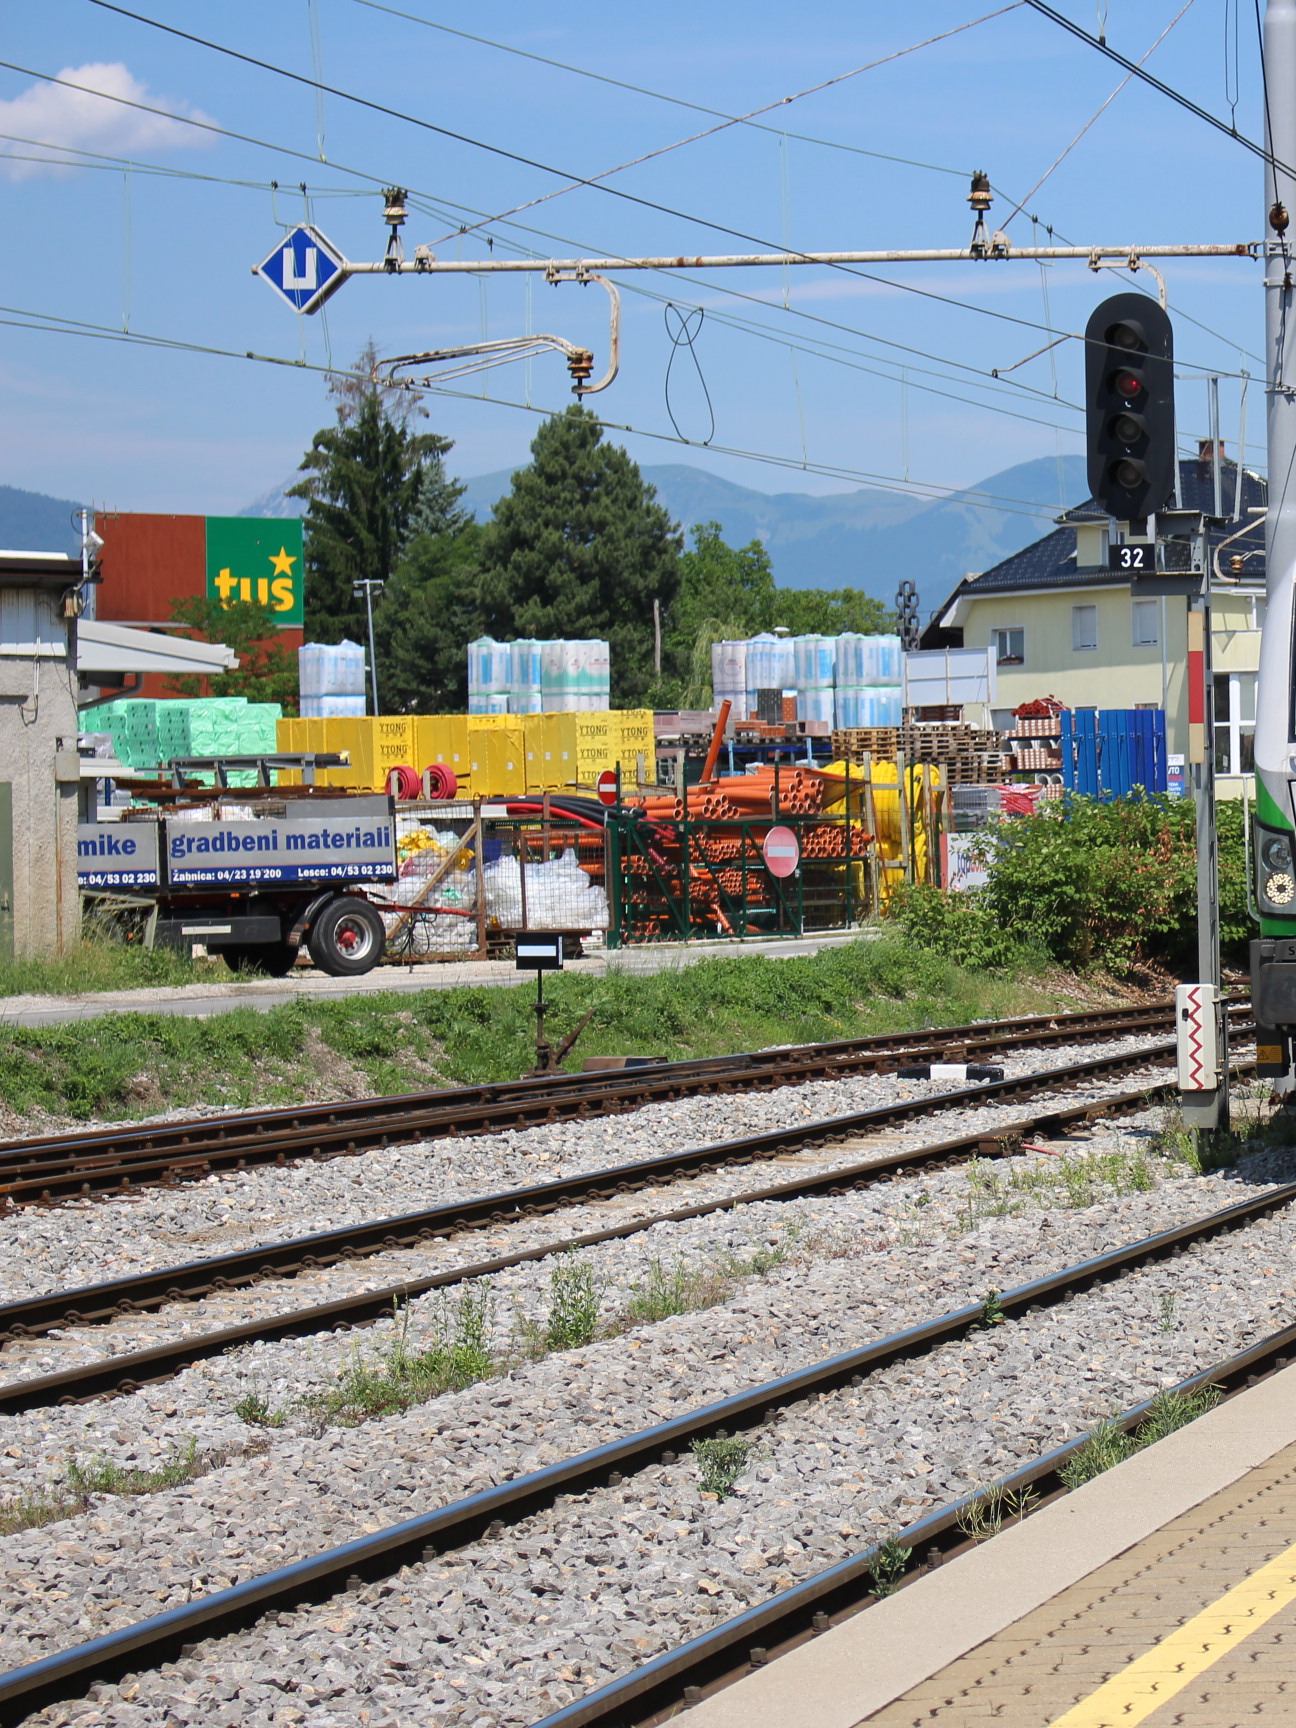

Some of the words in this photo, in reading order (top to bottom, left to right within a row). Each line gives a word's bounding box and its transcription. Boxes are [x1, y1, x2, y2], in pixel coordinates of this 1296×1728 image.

[283, 247, 317, 290] U
[1120, 548, 1144, 568] 32
[380, 722, 407, 734] YTONG
[579, 725, 608, 736] YTONG
[620, 726, 649, 738] YTONG
[380, 744, 408, 755] YTONG
[580, 748, 609, 759] YTONG
[581, 770, 601, 780] YTO
[171, 829, 278, 858] gradbeni
[286, 826, 390, 850] materiali
[217, 869, 247, 882] 04/23
[263, 868, 282, 879] 200
[331, 865, 360, 878] 04/53
[361, 865, 374, 876] 02
[375, 864, 393, 875] 230
[89, 873, 120, 887] 04/53
[122, 873, 134, 884] 02
[136, 872, 156, 884] 230
